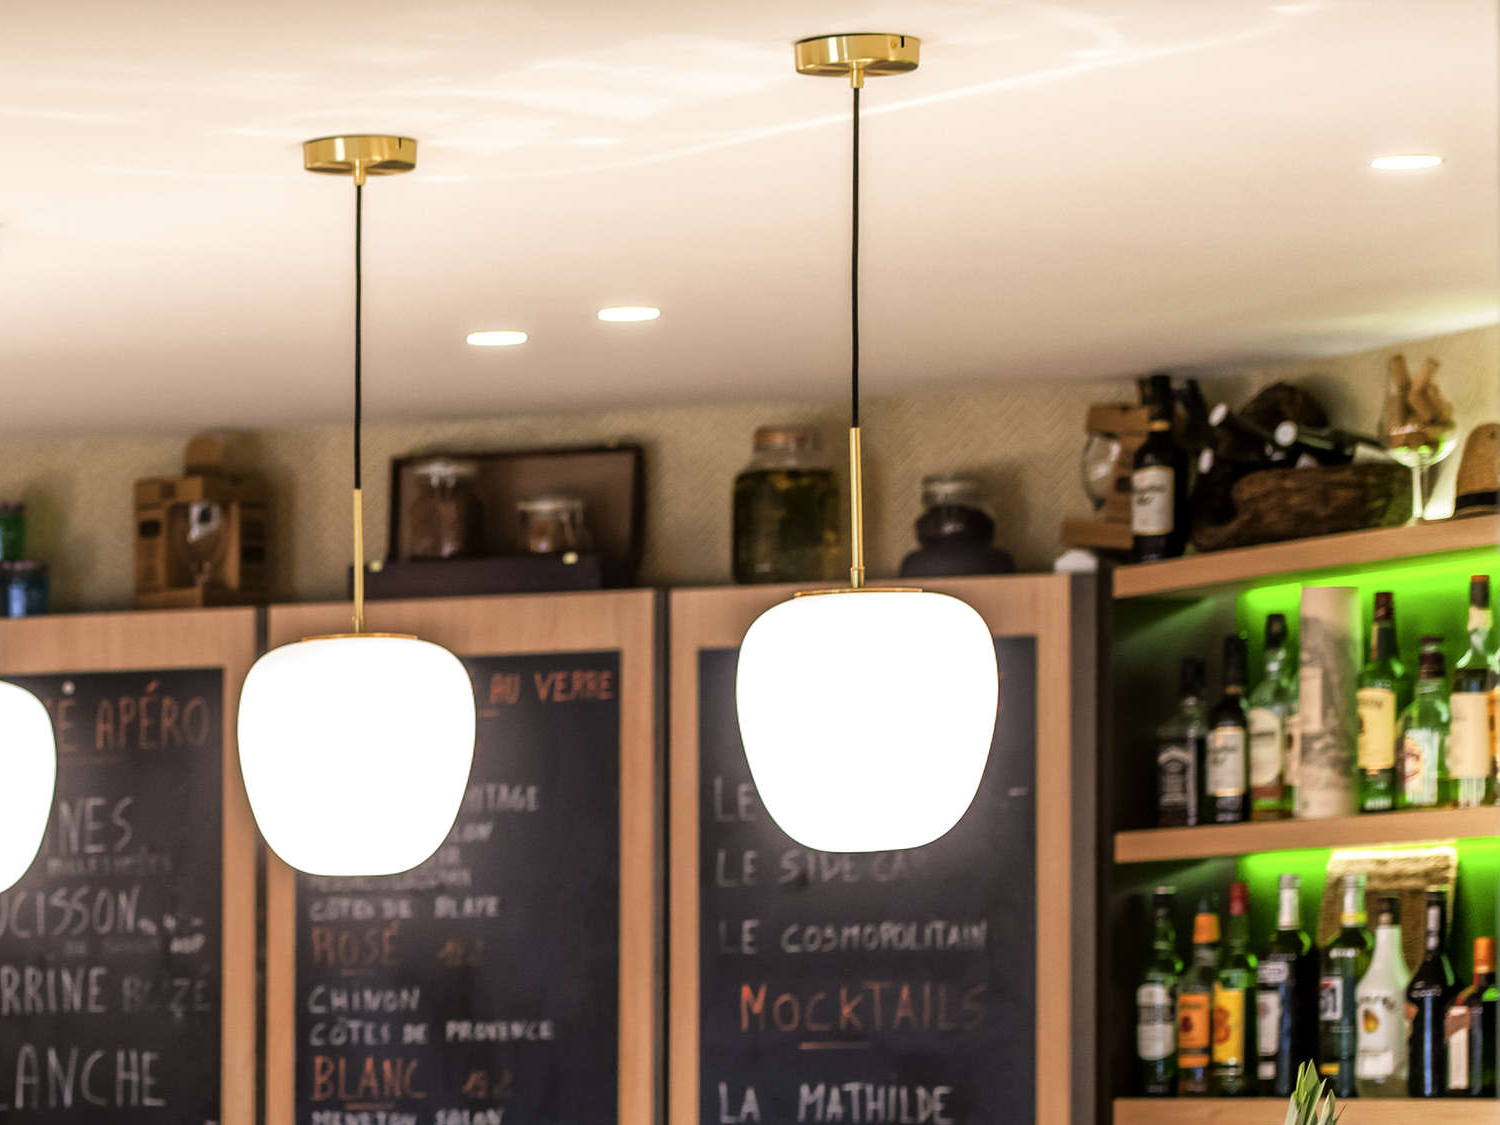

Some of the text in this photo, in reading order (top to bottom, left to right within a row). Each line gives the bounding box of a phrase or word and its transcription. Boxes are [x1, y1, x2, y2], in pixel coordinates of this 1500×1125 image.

[534, 669, 613, 702] VERRE
[95, 680, 211, 749] APÉRO
[716, 850, 758, 888] LE
[719, 919, 760, 955] LE
[307, 984, 420, 1014] CHINON
[739, 981, 987, 1033] MOCKTAILS
[311, 1054, 427, 1101] BLANC
[718, 1081, 953, 1125] LA MATHILDE
